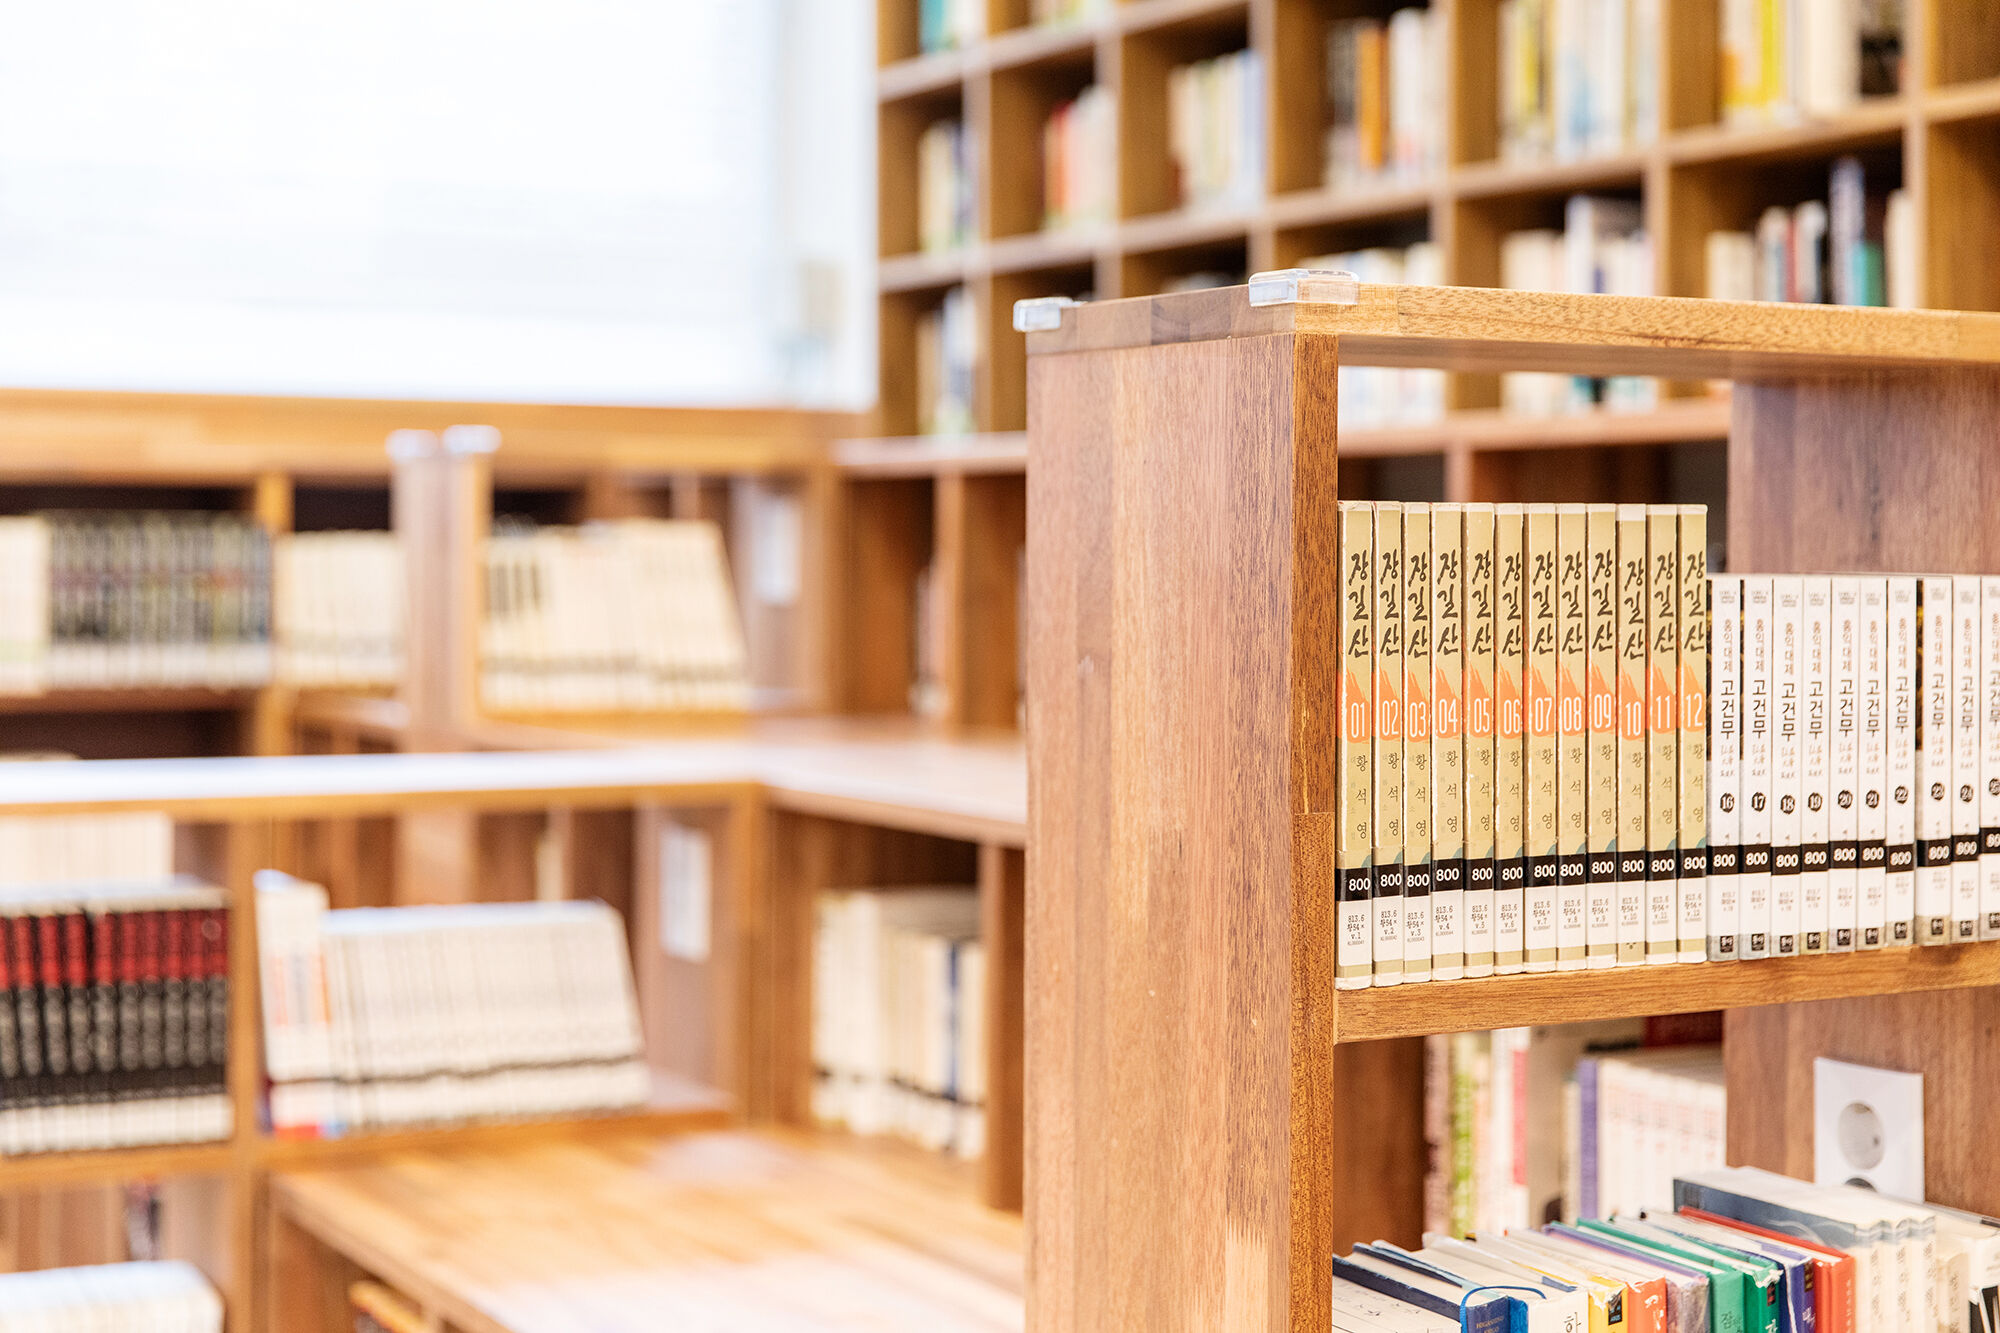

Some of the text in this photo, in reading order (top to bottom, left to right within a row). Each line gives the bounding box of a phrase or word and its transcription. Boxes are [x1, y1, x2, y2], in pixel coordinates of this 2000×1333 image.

[1348, 549, 1369, 658] 장길산
[1380, 549, 1399, 656] 장길산
[1408, 552, 1428, 658] 장길산
[1438, 549, 1458, 656] 장길산
[1472, 549, 1491, 655] 장길산
[1502, 552, 1521, 657] 장길산
[1533, 551, 1553, 654] 장길산
[1562, 551, 1583, 654] 장길산
[1592, 548, 1613, 652] 장길산
[1624, 560, 1644, 660] 장길산
[1654, 551, 1674, 653] 장길산
[1684, 551, 1704, 652] 장길산
[1382, 700, 1399, 735] 02
[1440, 699, 1458, 734] 04
[1474, 698, 1490, 733] 05
[1504, 700, 1520, 734] 06
[1535, 698, 1552, 732] 07
[1564, 697, 1582, 731] 08
[1594, 694, 1612, 729] 09
[1625, 701, 1641, 737] 10
[1656, 696, 1671, 730] 11
[1686, 693, 1702, 728] 12
[1721, 680, 1735, 740] 고건무
[1752, 680, 1766, 739] 고건무
[1781, 683, 1796, 742] 고건무
[1809, 681, 1823, 740] 고건무
[1839, 680, 1853, 737] 고건무
[1867, 680, 1880, 737] 고건무
[1896, 676, 1908, 734] 고건무
[1932, 673, 1945, 730] 고건무
[1961, 676, 1974, 733] 고건무
[1350, 702, 1366, 738] 01
[1410, 702, 1427, 737] 03
[1356, 754, 1368, 839] 황석영
[1388, 752, 1399, 836] 황석영
[1416, 754, 1427, 837] 황석영
[1446, 750, 1458, 833] 황석영
[1480, 749, 1490, 831] 황석영
[1510, 750, 1520, 831] 황석영
[1542, 748, 1553, 829] 황석영
[1570, 748, 1582, 828] 황석영
[1601, 744, 1613, 824] 황석영
[1632, 752, 1643, 832] 황석영
[1662, 745, 1673, 824] 황석영
[1693, 744, 1704, 823] 황석영
[1839, 791, 1852, 808] 20
[1866, 791, 1879, 807] 21
[1895, 787, 1908, 803] 22
[1721, 793, 1734, 812] 16
[1753, 793, 1766, 811] 17
[1782, 796, 1795, 813] 18
[1809, 793, 1822, 811] 19
[1652, 859, 1674, 872] 800
[1684, 857, 1706, 869] 800
[1713, 854, 1735, 867] 800
[1746, 852, 1768, 866] 800
[1776, 854, 1798, 867] 800
[1804, 852, 1826, 865] 800
[1834, 848, 1856, 861] 800
[1863, 847, 1884, 861] 800
[1890, 851, 1911, 865] 800
[1929, 846, 1949, 859] 800
[1956, 842, 1977, 855] 800
[1381, 874, 1402, 887] 800
[1407, 874, 1429, 887] 800
[1436, 868, 1459, 881] 800
[1472, 868, 1492, 880] 800
[1502, 867, 1523, 880] 800
[1534, 864, 1556, 878] 800
[1560, 864, 1583, 877] 800
[1592, 861, 1614, 874] 800
[1622, 860, 1644, 873] 800
[1349, 878, 1371, 891] 800
[1381, 910, 1397, 918] 813.6
[1407, 912, 1424, 920] 813.6
[1436, 906, 1453, 914] 813.6
[1501, 904, 1517, 912] 813.6
